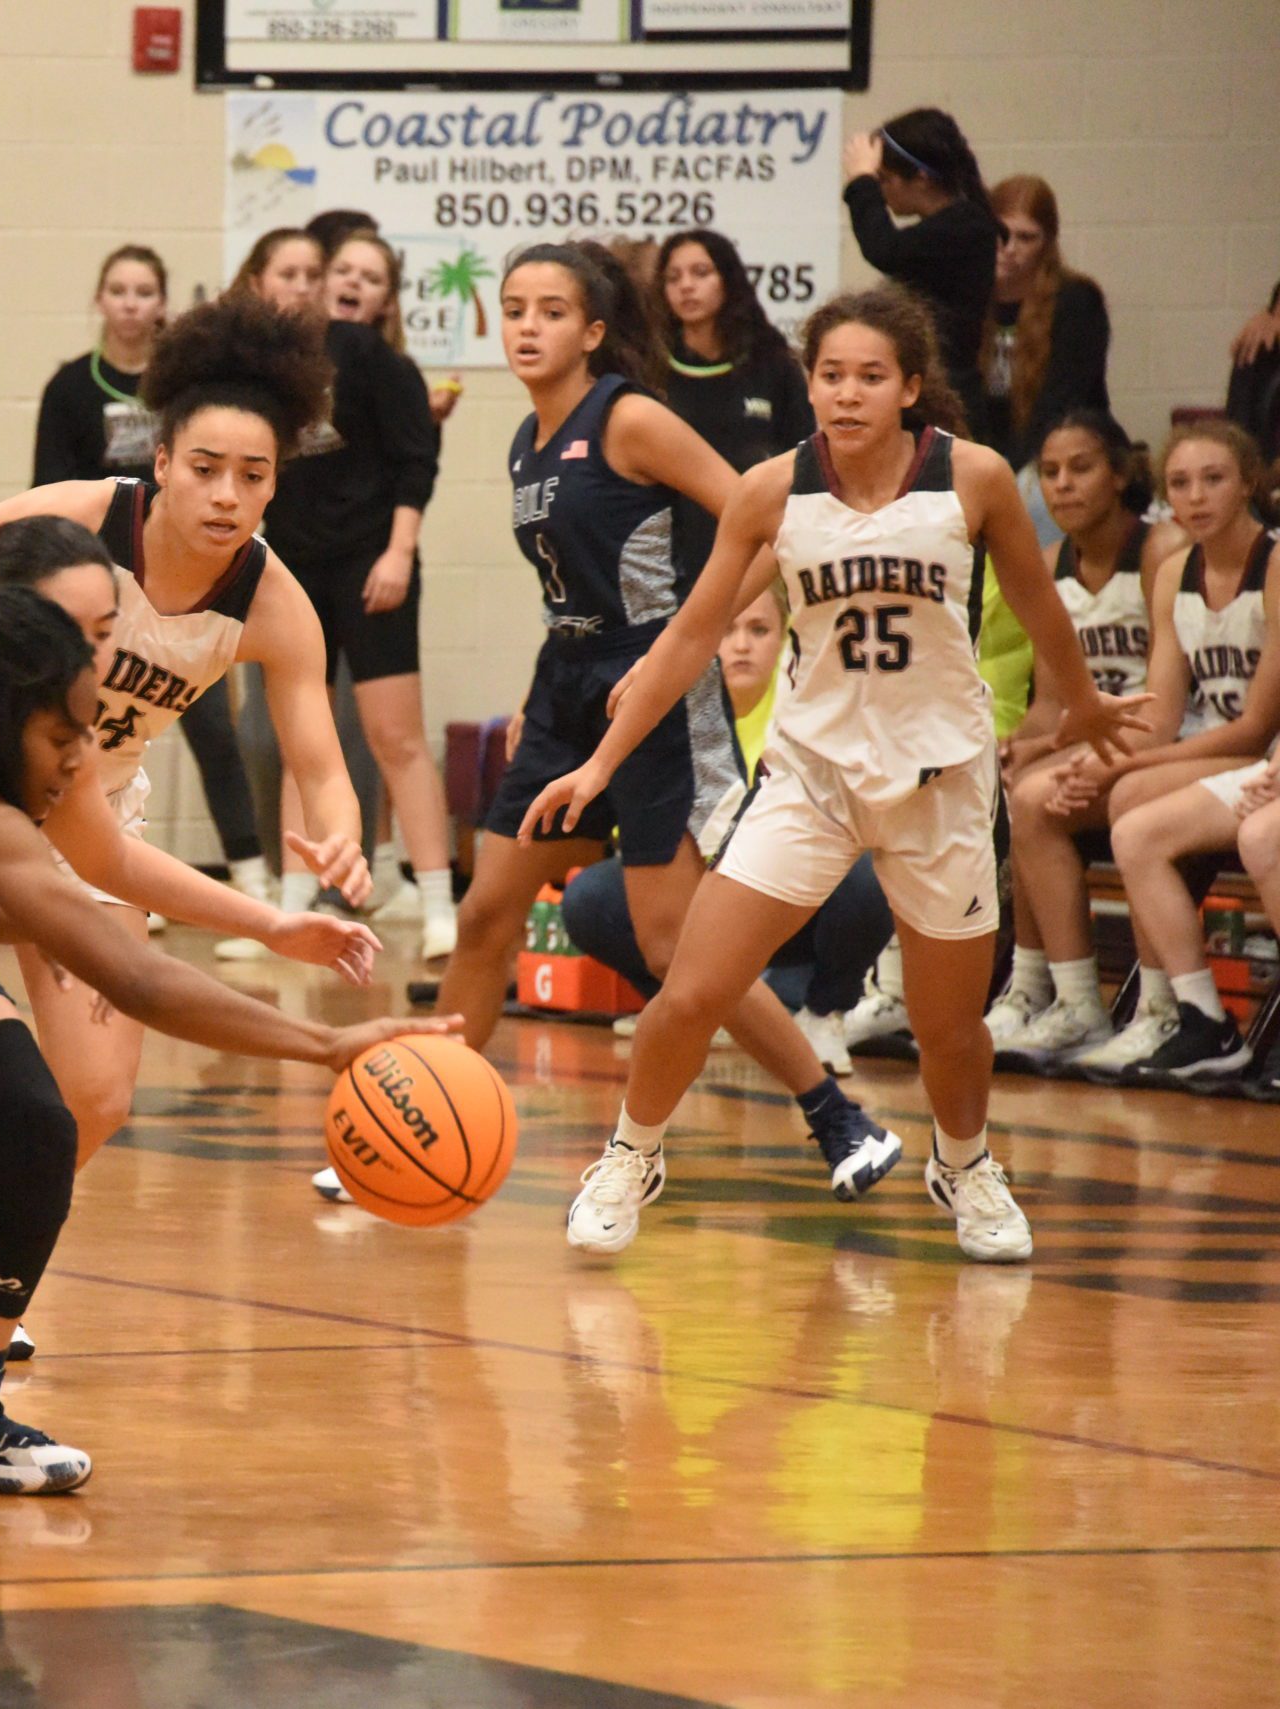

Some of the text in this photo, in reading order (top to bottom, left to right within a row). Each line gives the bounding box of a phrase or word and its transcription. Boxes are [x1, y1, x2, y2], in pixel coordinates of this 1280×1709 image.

[324, 92, 828, 163] Coastal Podiatry
[374, 155, 776, 186] Paul Hilbert, DPM, FACFAS
[435, 191, 715, 227] 850.936.5226
[798, 554, 947, 606] RAIDERS
[834, 604, 913, 674] 25
[534, 962, 553, 1003] G
[363, 1049, 440, 1152] Wilson
